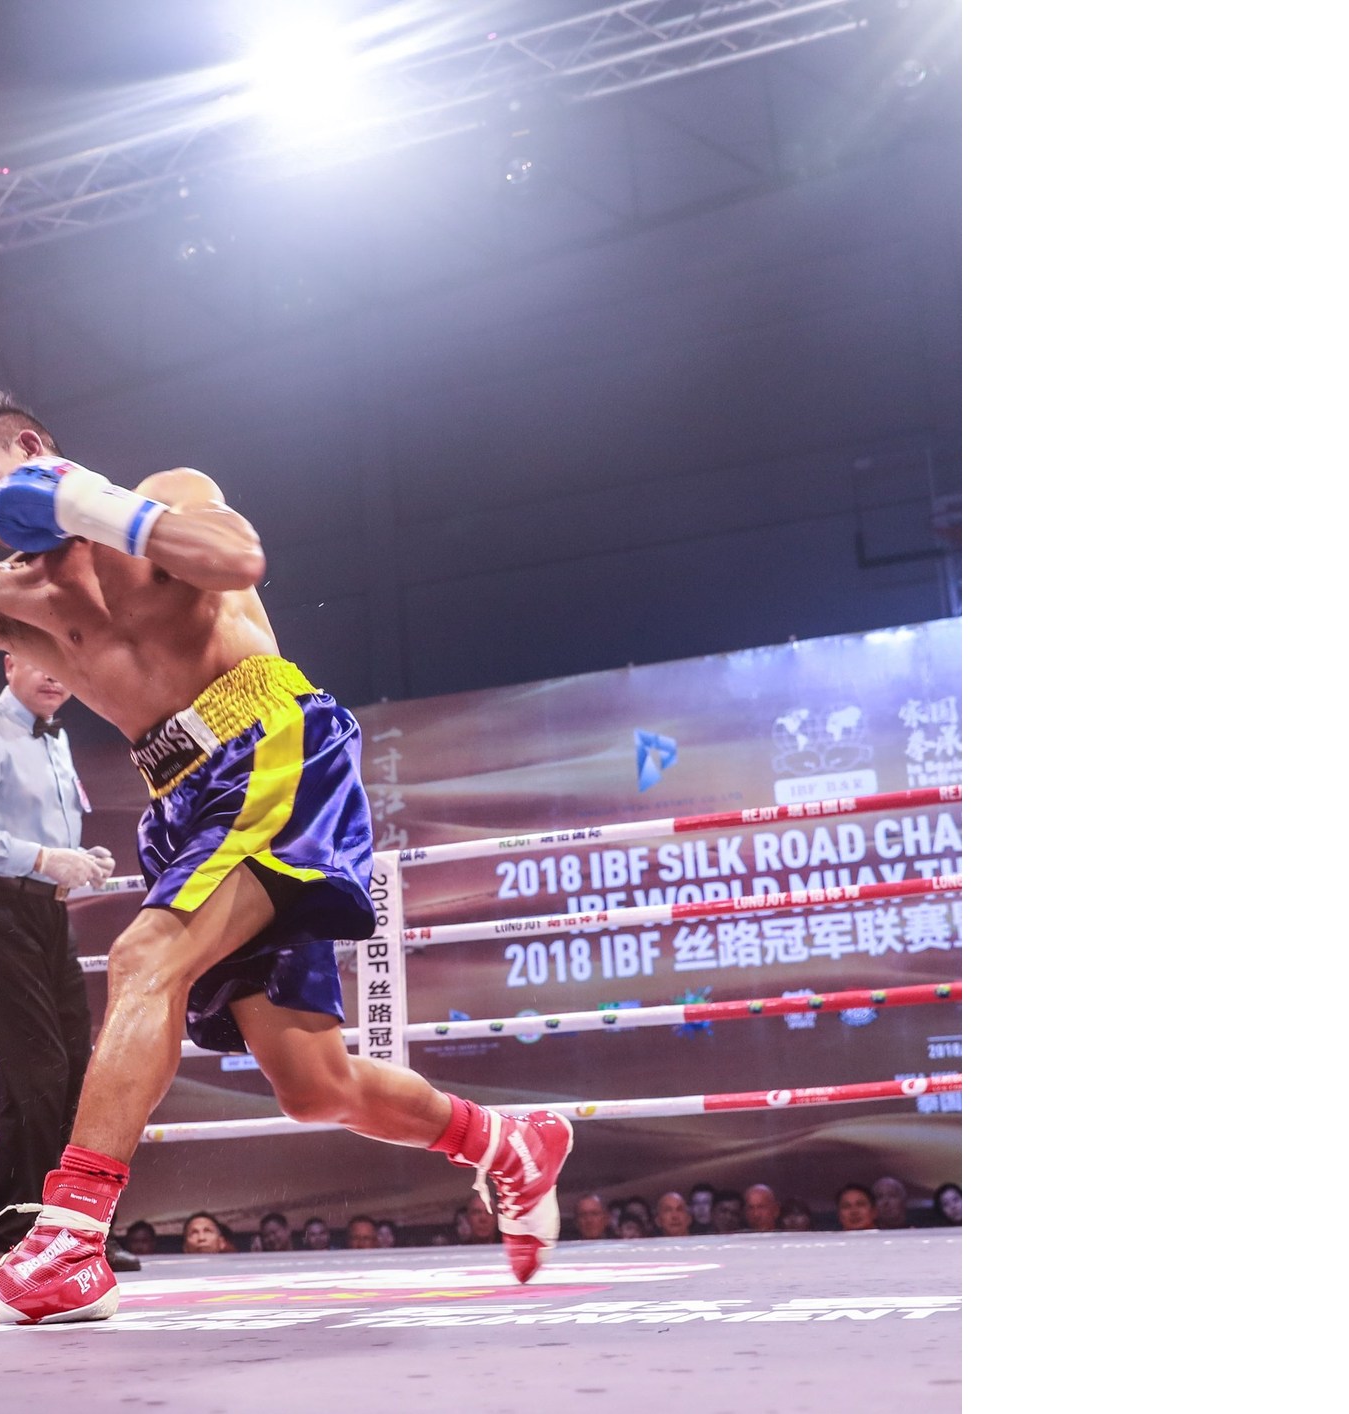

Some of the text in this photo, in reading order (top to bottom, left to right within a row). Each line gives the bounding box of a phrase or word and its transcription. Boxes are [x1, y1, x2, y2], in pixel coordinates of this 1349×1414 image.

[741, 806, 779, 822] REJOY
[496, 855, 582, 899] 2018
[589, 847, 649, 889] IBF
[657, 836, 747, 882] SILK
[753, 823, 866, 873] ROAD
[367, 936, 390, 974] IBF
[505, 902, 962, 988] 2018 IBF 丝路冠军联赛
[14, 1257, 40, 1280] PRO
[37, 1229, 81, 1264] BOXING
[326, 1307, 955, 1329] TOURNAMENT
